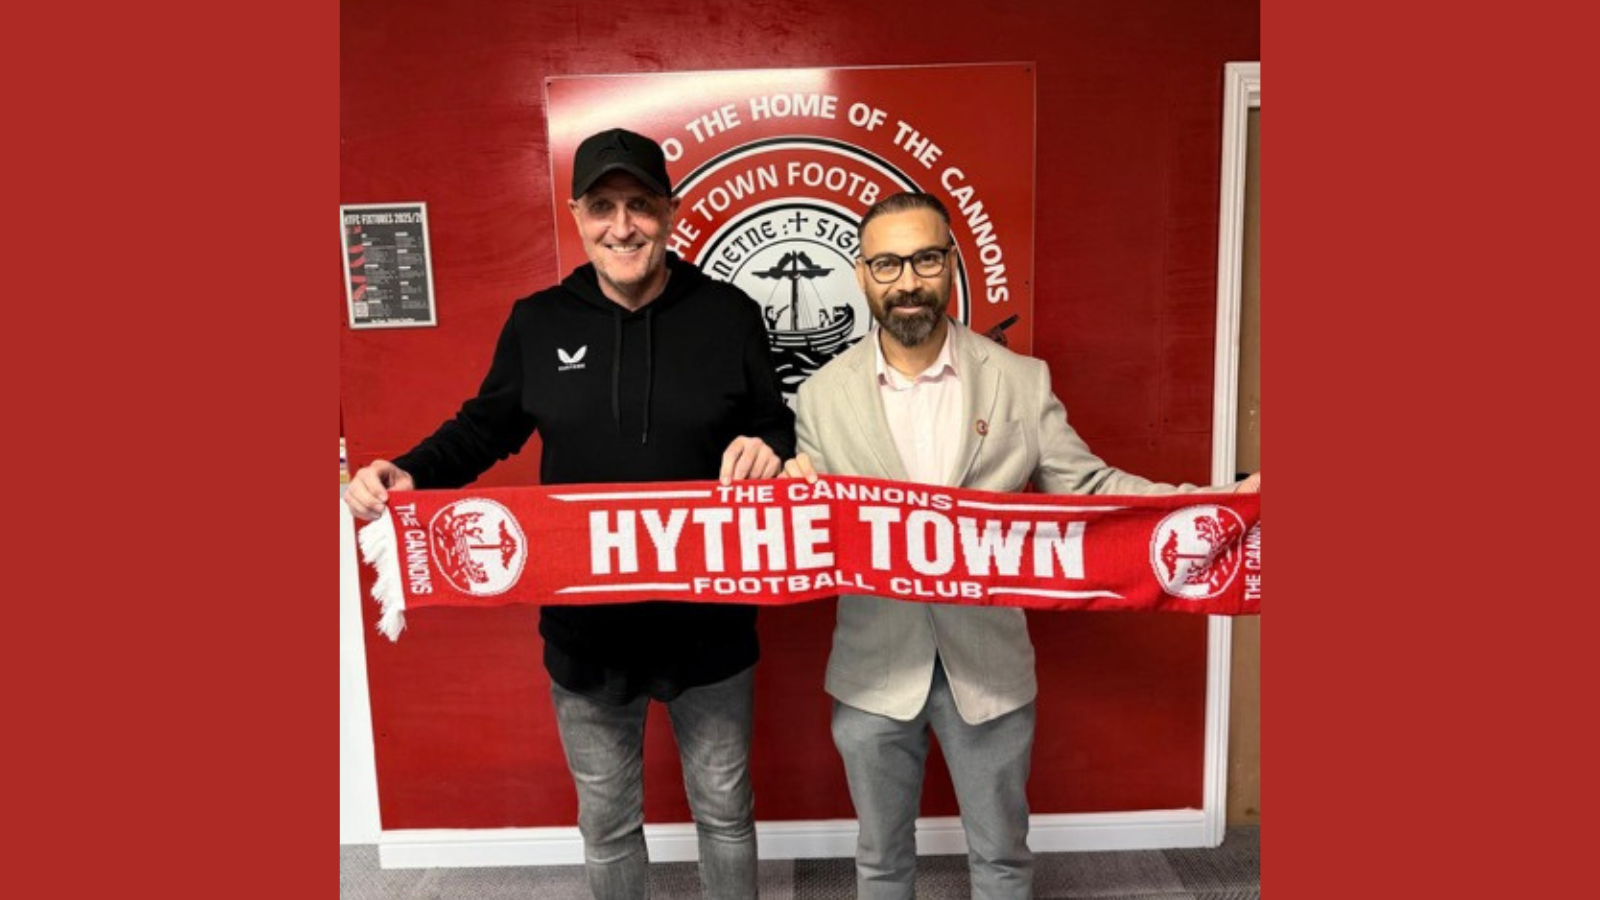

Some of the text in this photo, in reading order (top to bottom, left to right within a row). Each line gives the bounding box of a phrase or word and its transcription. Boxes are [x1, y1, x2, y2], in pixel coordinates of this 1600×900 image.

[661, 93, 1009, 304] O THE HOME OF THE CANNONS
[692, 164, 778, 222] TOWN
[787, 161, 881, 207] FOOTB
[717, 479, 953, 511] THE CANNONS
[395, 502, 433, 594] THE CANNONS
[589, 504, 1087, 580] HYTHE TOWN
[693, 569, 983, 599] FOOTBALL CLUB
[1243, 574, 1260, 601] THE
